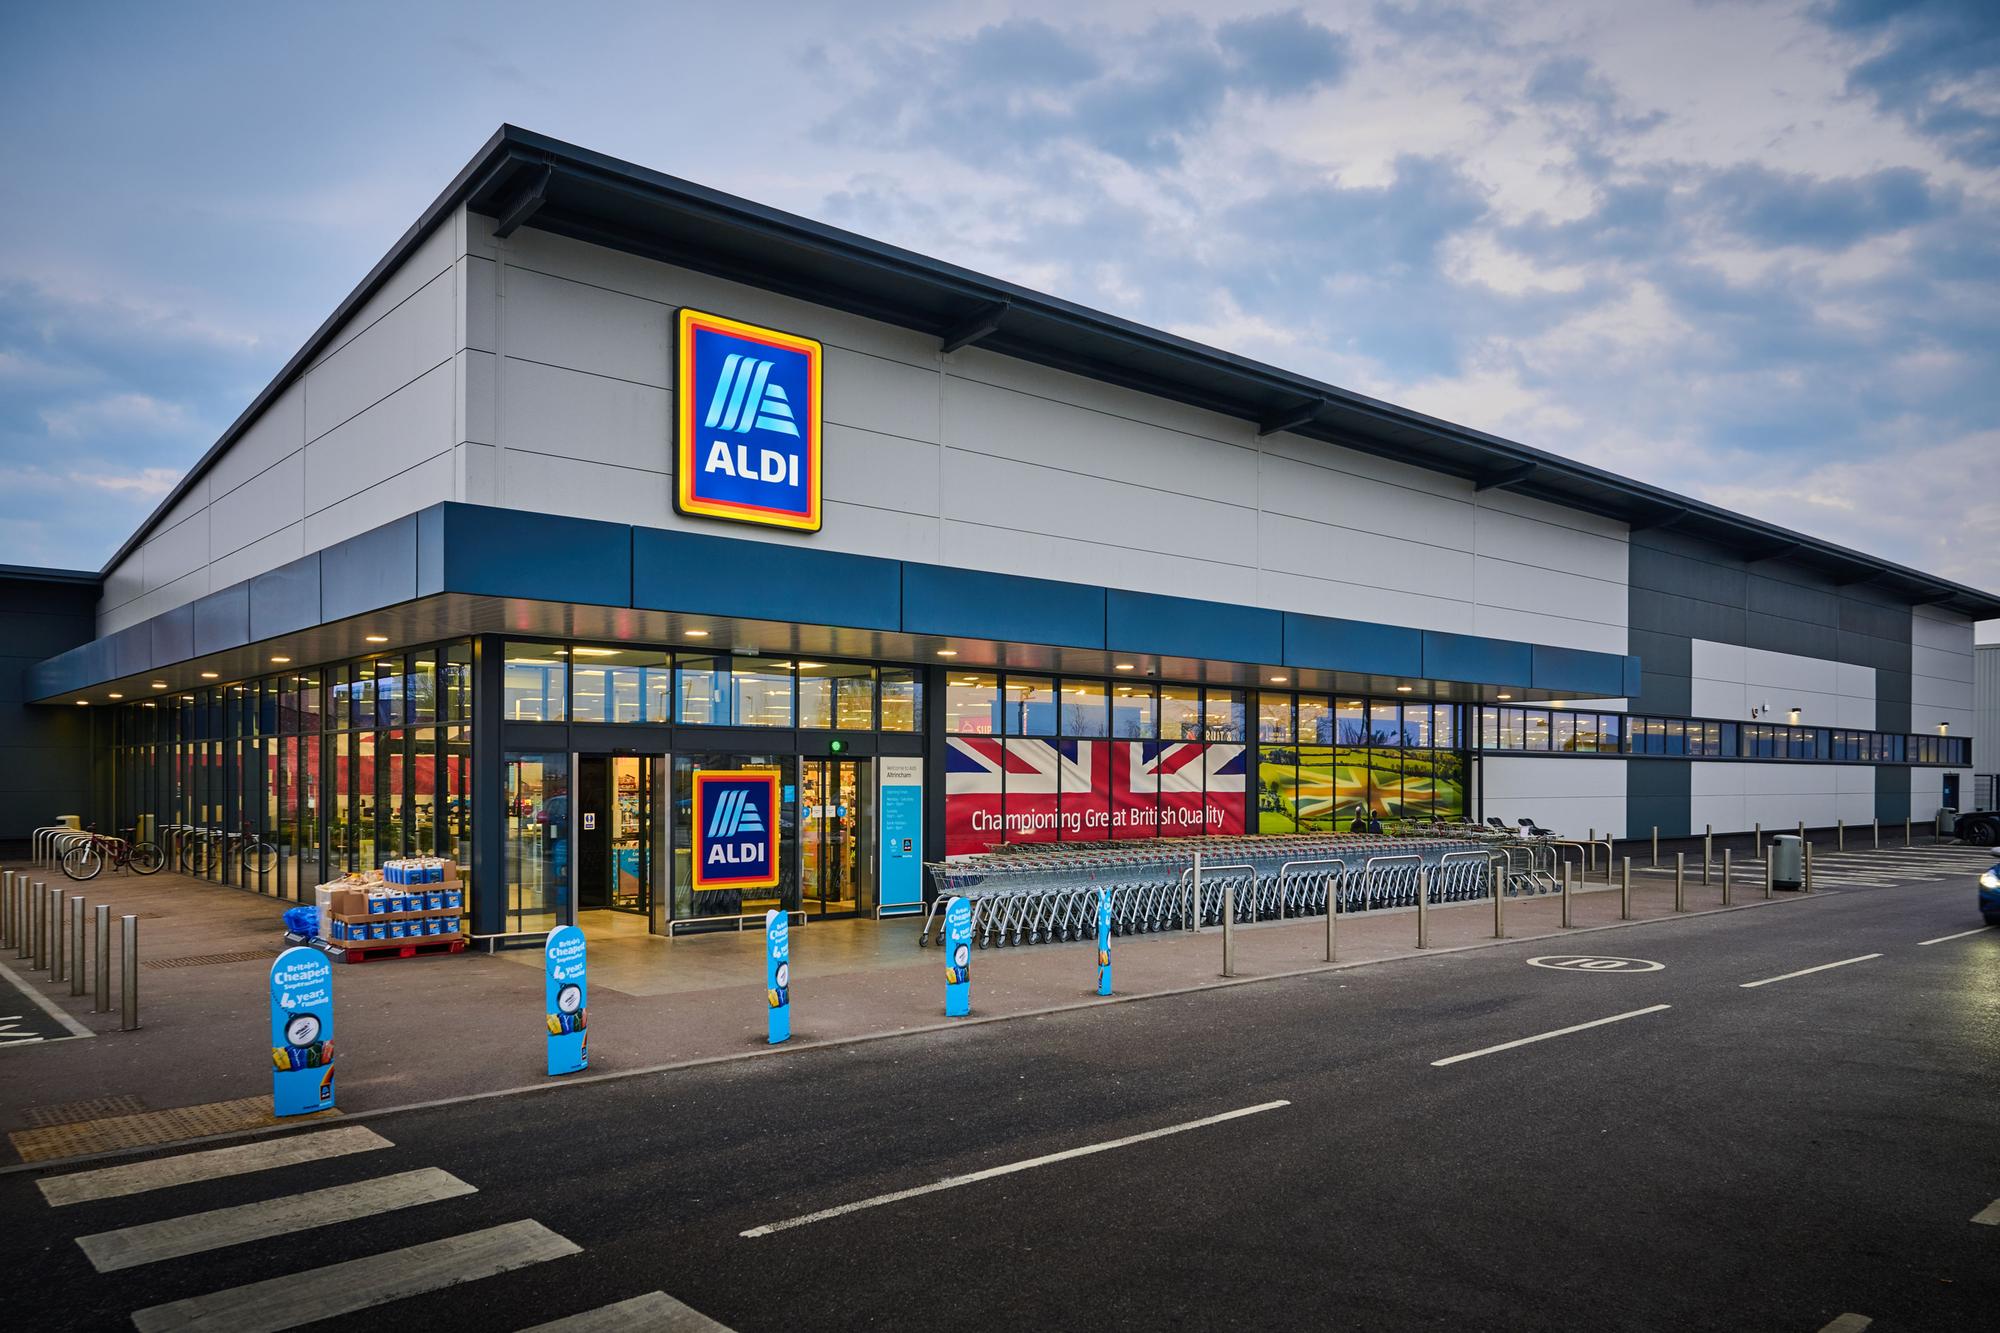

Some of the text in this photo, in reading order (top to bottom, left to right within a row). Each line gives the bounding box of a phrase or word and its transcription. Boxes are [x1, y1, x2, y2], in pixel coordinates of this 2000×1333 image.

[704, 440, 799, 487] ALDI
[971, 805, 1225, 833] Championing Great British Quality
[707, 842, 765, 865] ALDI
[553, 965, 565, 979] 4
[1555, 958, 1629, 969] 10
[274, 965, 330, 985] Cheapest
[280, 989, 325, 1008] 4 years
